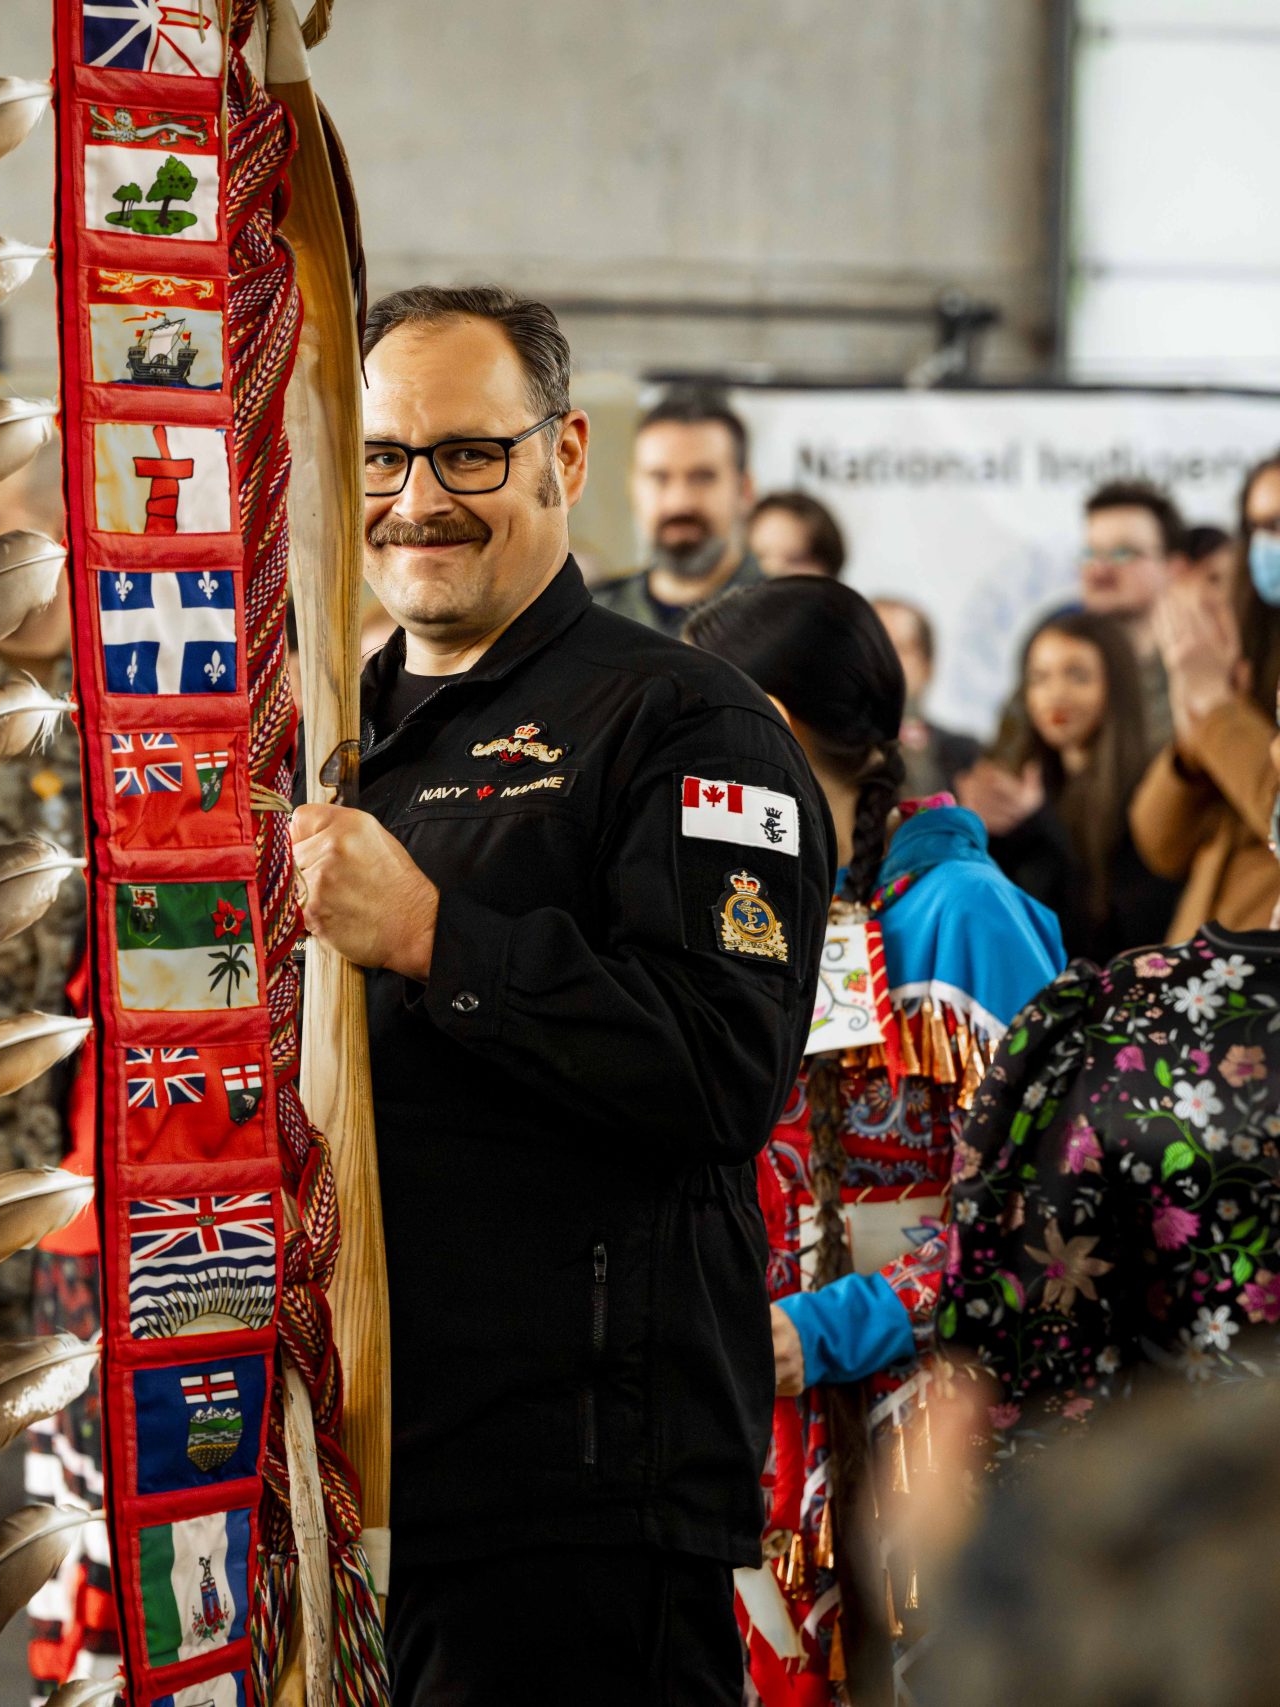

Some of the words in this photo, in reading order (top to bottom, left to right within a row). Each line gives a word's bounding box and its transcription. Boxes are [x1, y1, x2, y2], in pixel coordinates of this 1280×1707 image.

[796, 439, 1023, 487] National
[418, 786, 470, 802] NAVY
[499, 776, 565, 798] MARINE
